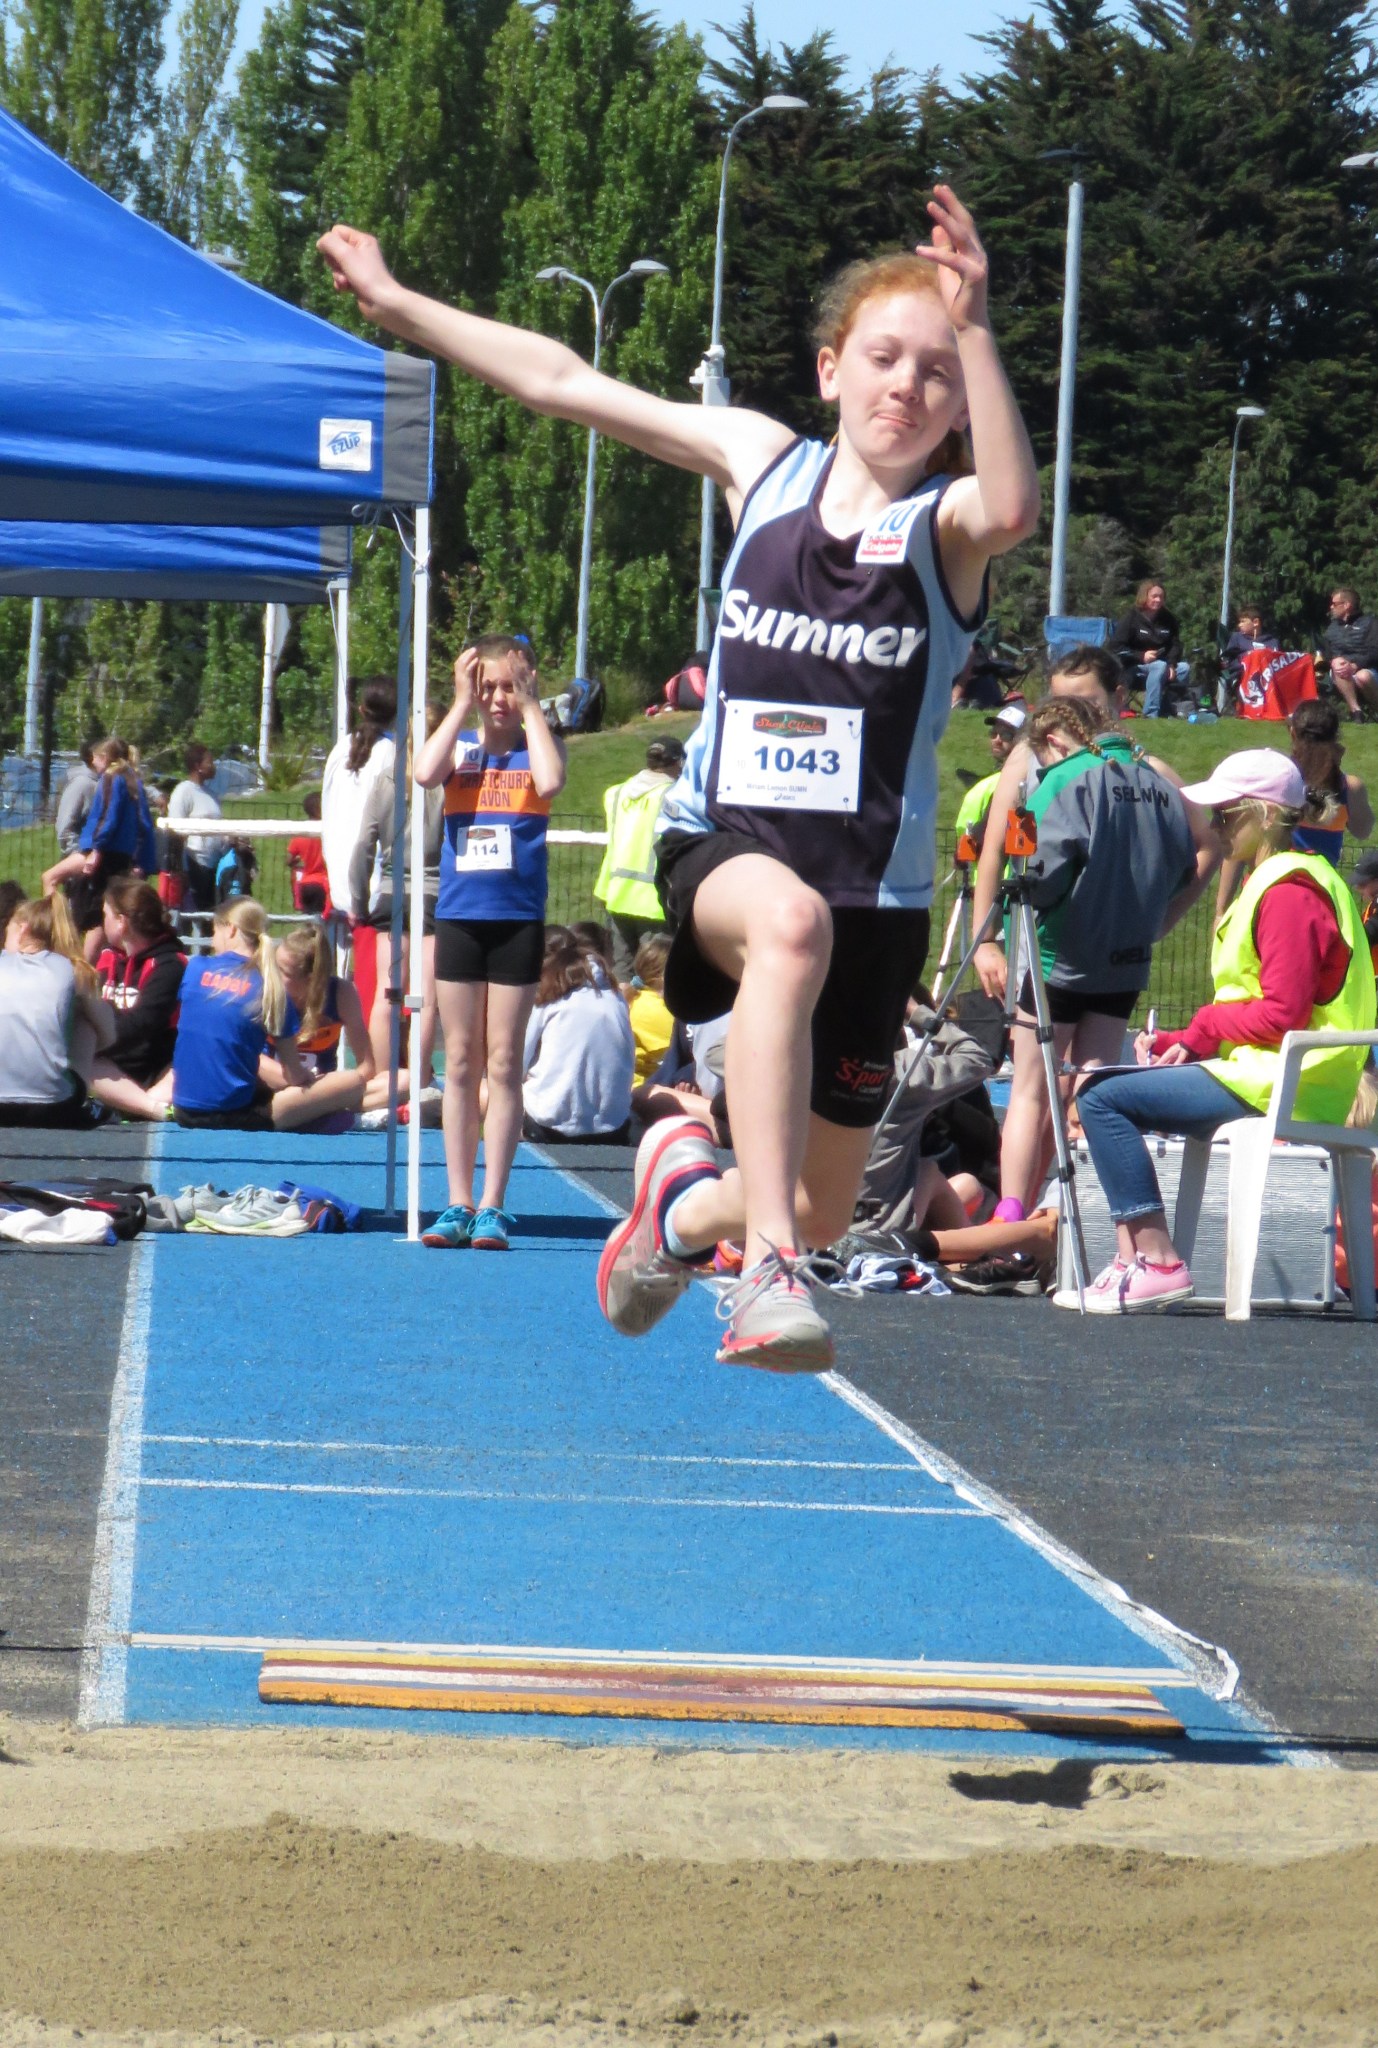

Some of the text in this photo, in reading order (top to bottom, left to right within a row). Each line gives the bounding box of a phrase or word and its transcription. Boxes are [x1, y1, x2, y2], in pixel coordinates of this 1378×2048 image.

[878, 503, 917, 533] 10
[720, 589, 927, 668] Sumner
[754, 745, 841, 775] 1043
[479, 790, 511, 808] AVON
[472, 843, 499, 856] 114
